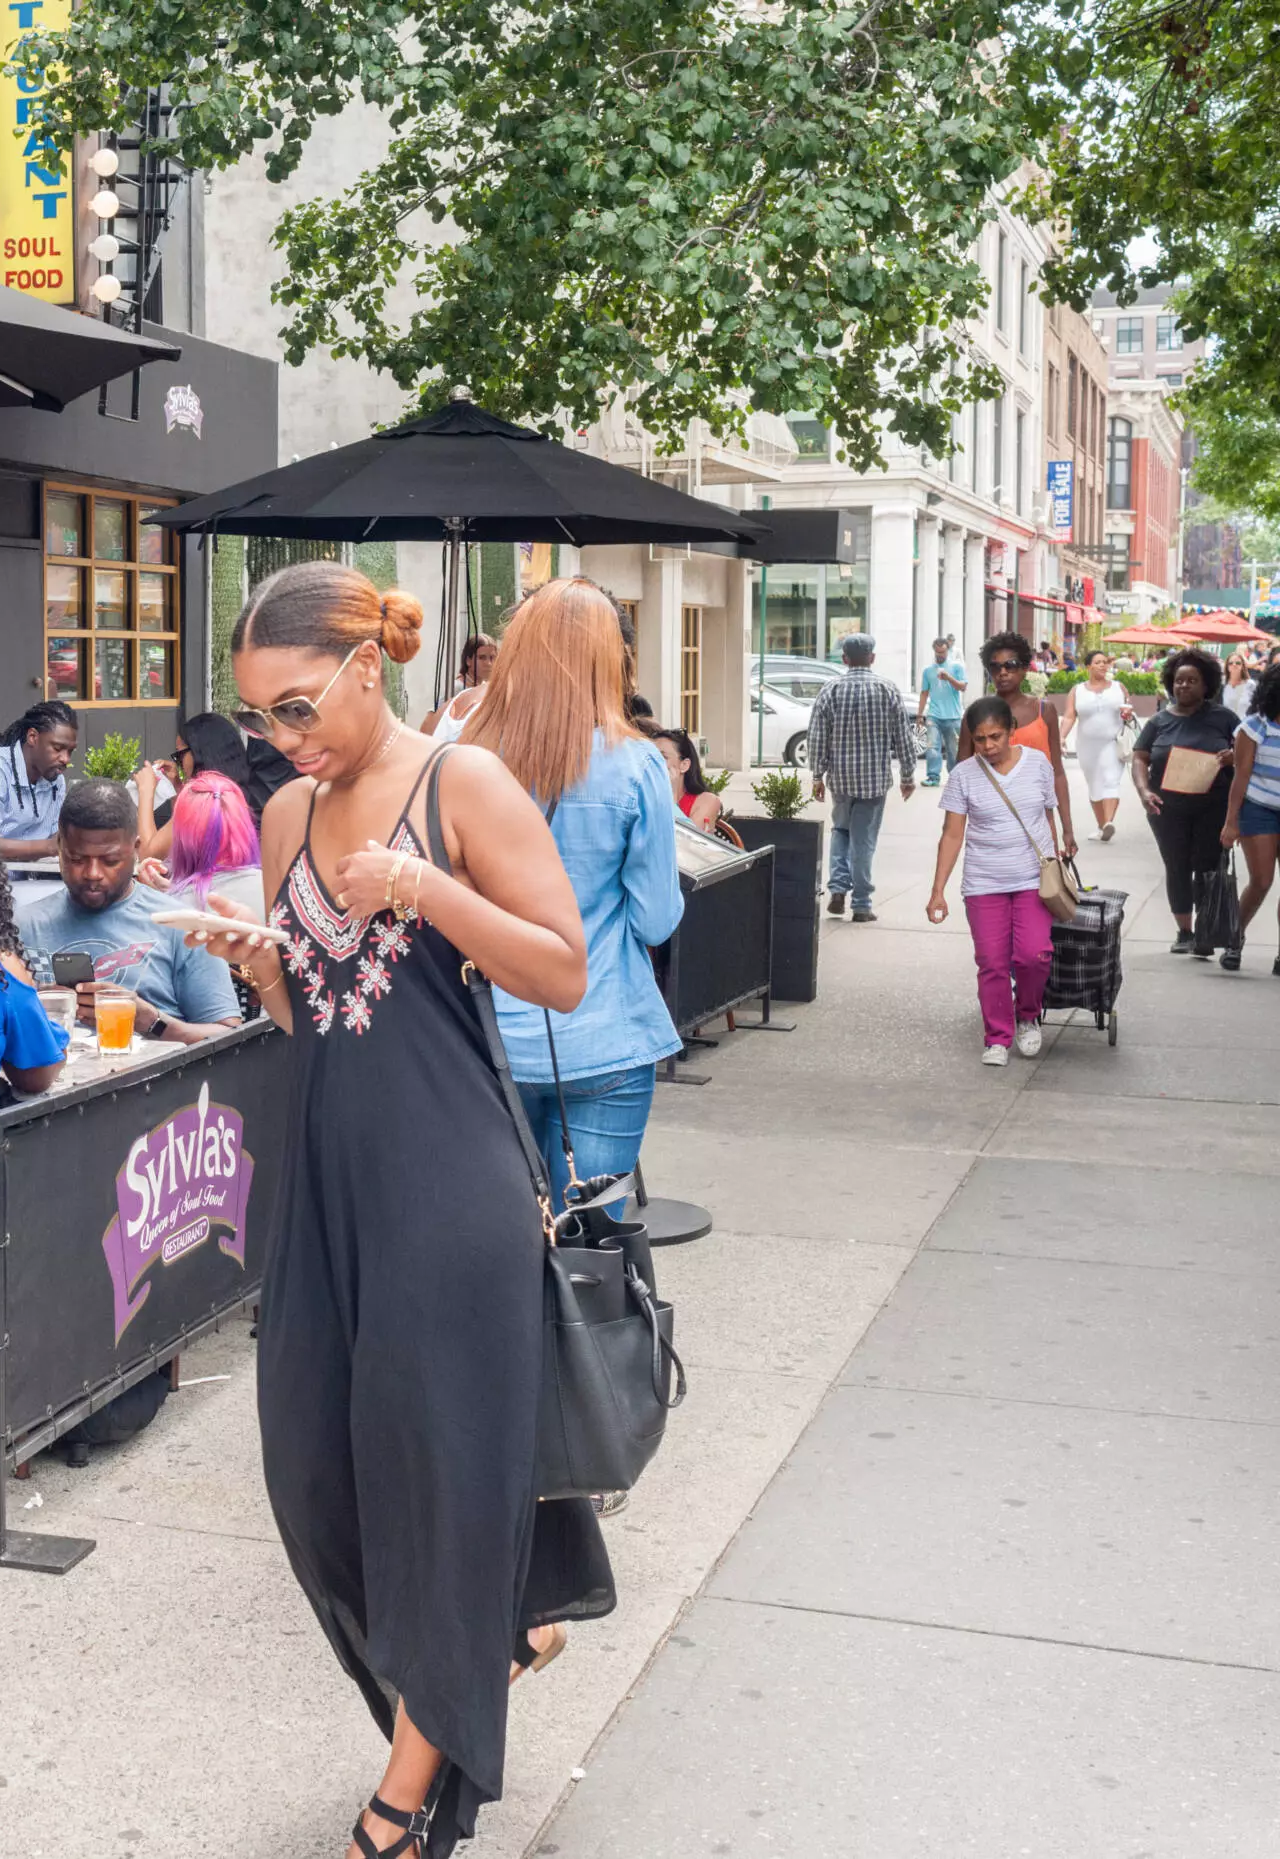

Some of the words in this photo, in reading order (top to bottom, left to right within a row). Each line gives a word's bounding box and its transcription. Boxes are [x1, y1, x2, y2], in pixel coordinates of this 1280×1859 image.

[3, 236, 61, 259] SOUL
[5, 269, 64, 290] FOOD
[1055, 463, 1071, 497] SALE
[1055, 499, 1070, 525] FOR
[125, 1081, 237, 1238] Sylvia's
[139, 1215, 169, 1252] Queen
[169, 1197, 182, 1229] of
[181, 1187, 203, 1215] Soul
[202, 1184, 227, 1207] Food
[164, 1222, 205, 1258] RESTAURANT
